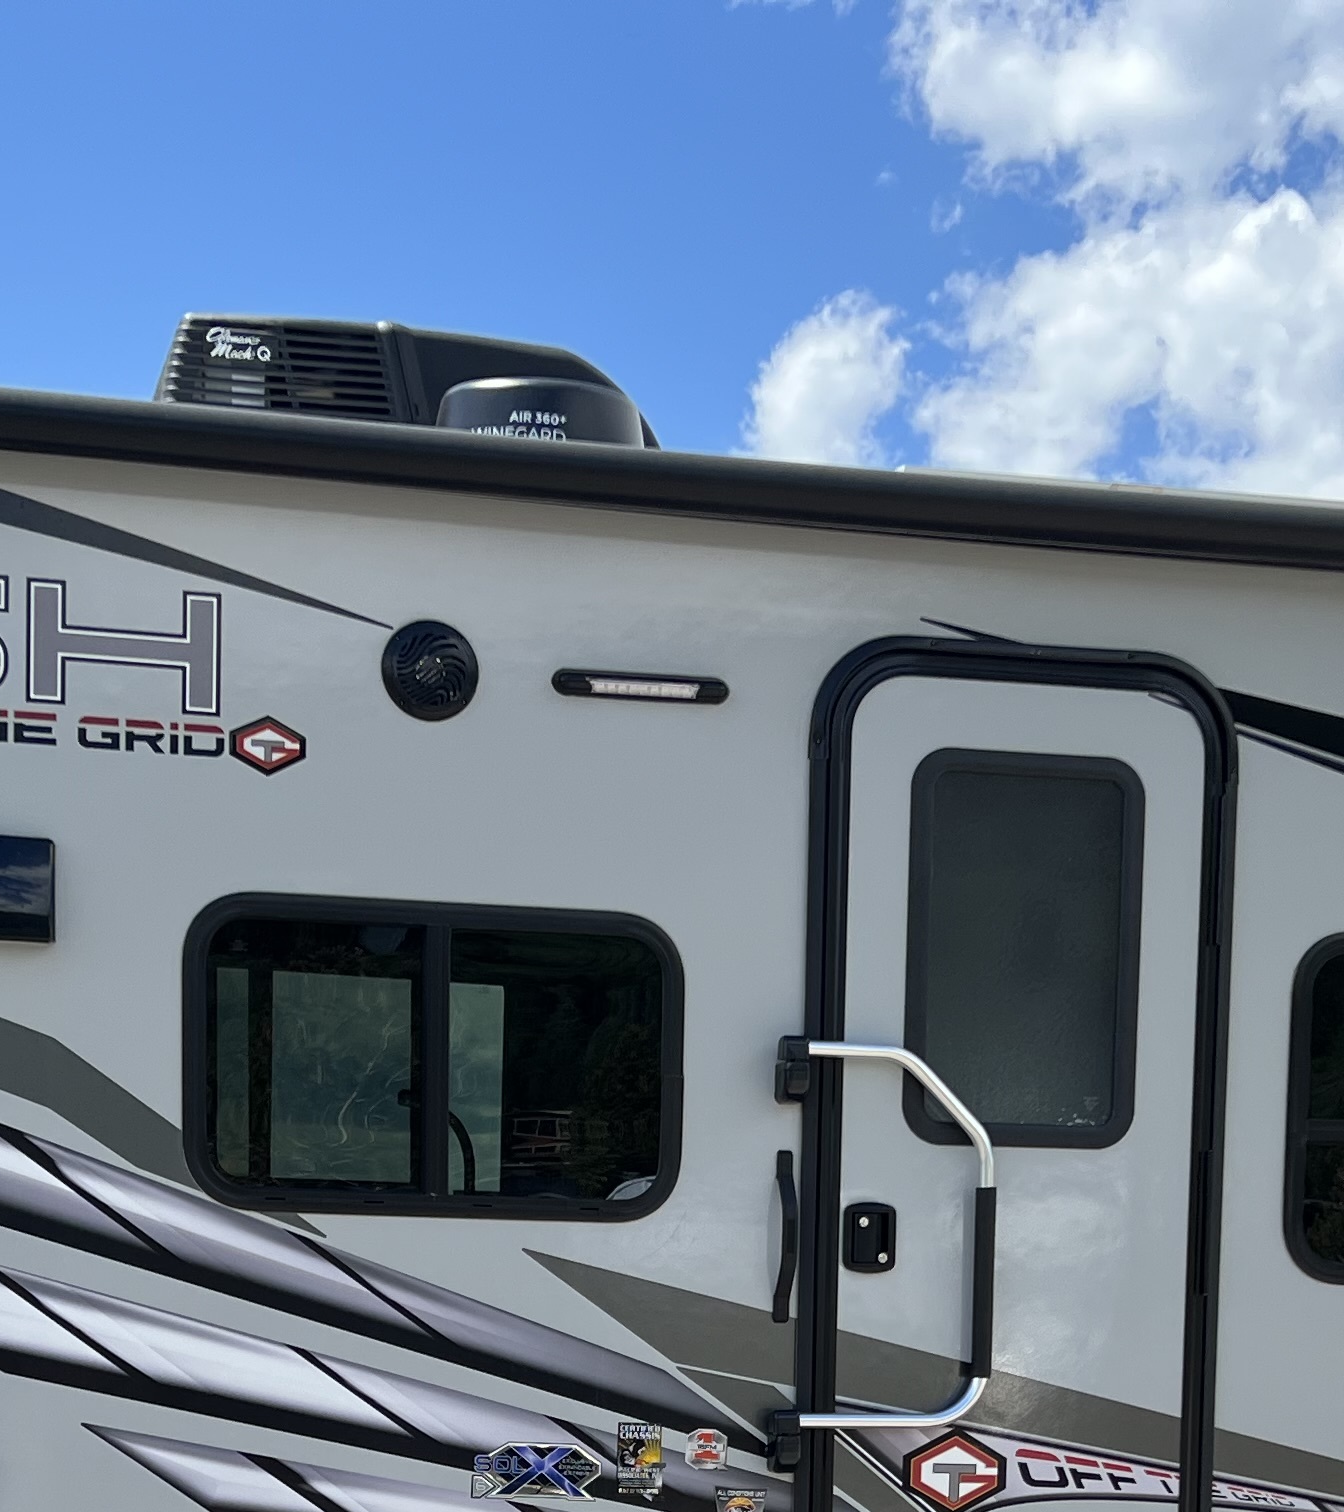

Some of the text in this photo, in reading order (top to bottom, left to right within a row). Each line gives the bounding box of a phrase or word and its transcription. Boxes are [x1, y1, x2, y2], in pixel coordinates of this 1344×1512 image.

[256, 345, 272, 362] Q
[509, 410, 567, 426] AIR 360+
[77, 714, 225, 758] GRID
[619, 1431, 661, 1440] CHASSIS
[1015, 1448, 1137, 1491] OFF
